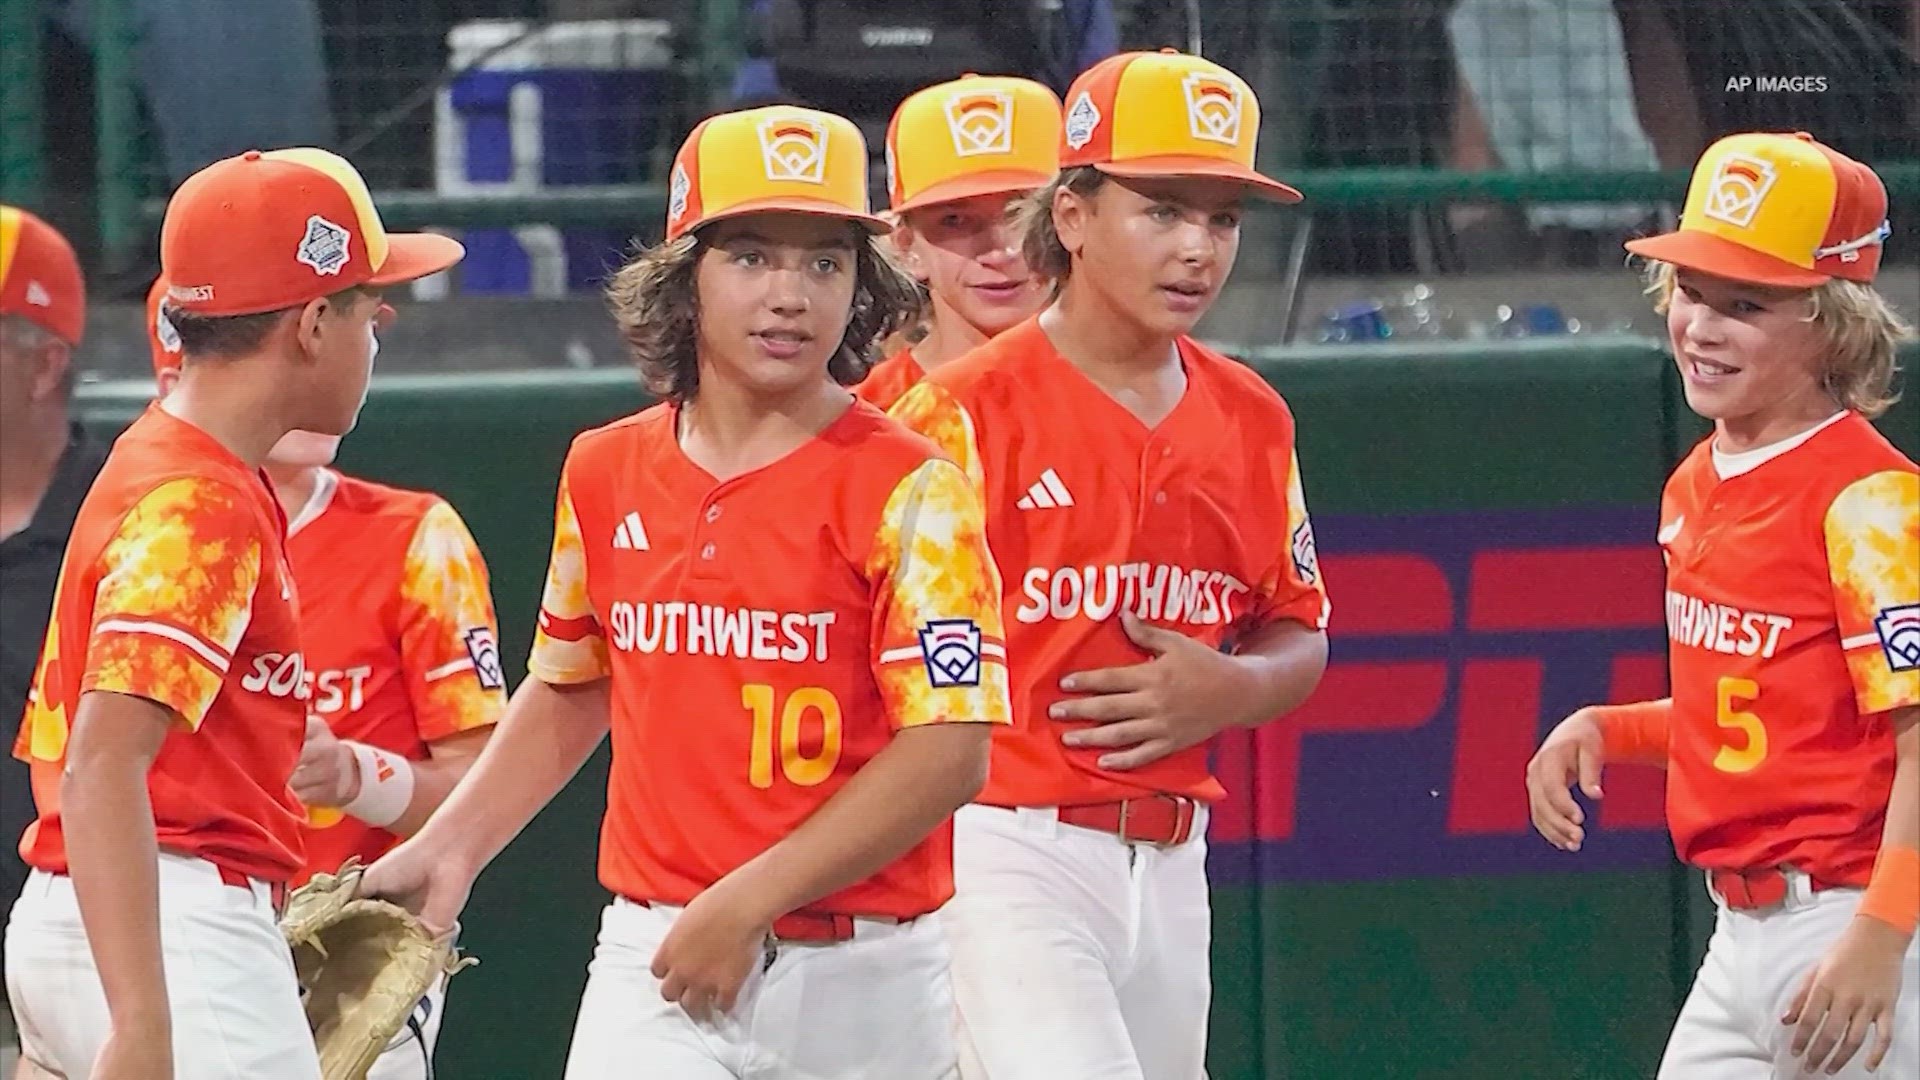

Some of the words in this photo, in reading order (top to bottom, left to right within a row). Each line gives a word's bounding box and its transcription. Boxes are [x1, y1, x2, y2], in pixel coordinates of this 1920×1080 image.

[609, 600, 837, 664] SOUTHWEST
[1015, 561, 1251, 626] SOUTHWEST
[741, 683, 844, 790] 10
[1712, 675, 1769, 774] 5
